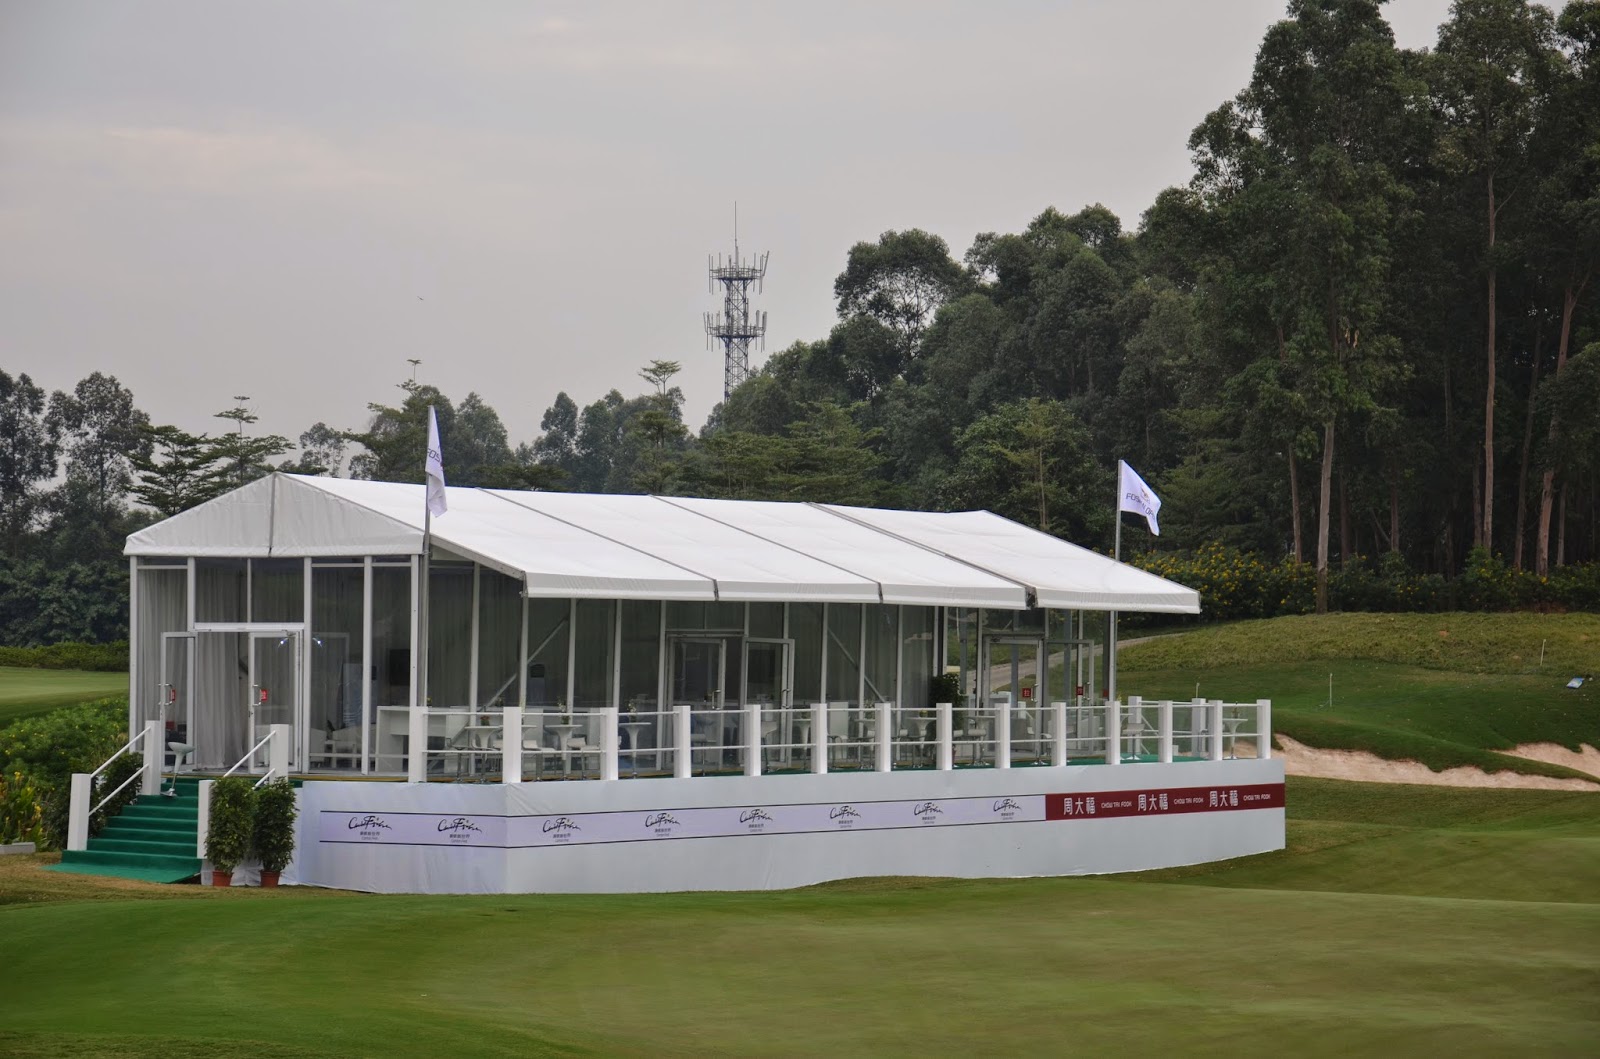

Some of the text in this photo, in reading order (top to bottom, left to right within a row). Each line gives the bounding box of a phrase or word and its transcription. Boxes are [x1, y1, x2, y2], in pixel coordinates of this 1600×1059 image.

[1063, 797, 1096, 815] 周大福
[1137, 793, 1169, 812] 周大福
[1209, 790, 1239, 808] 周大福
